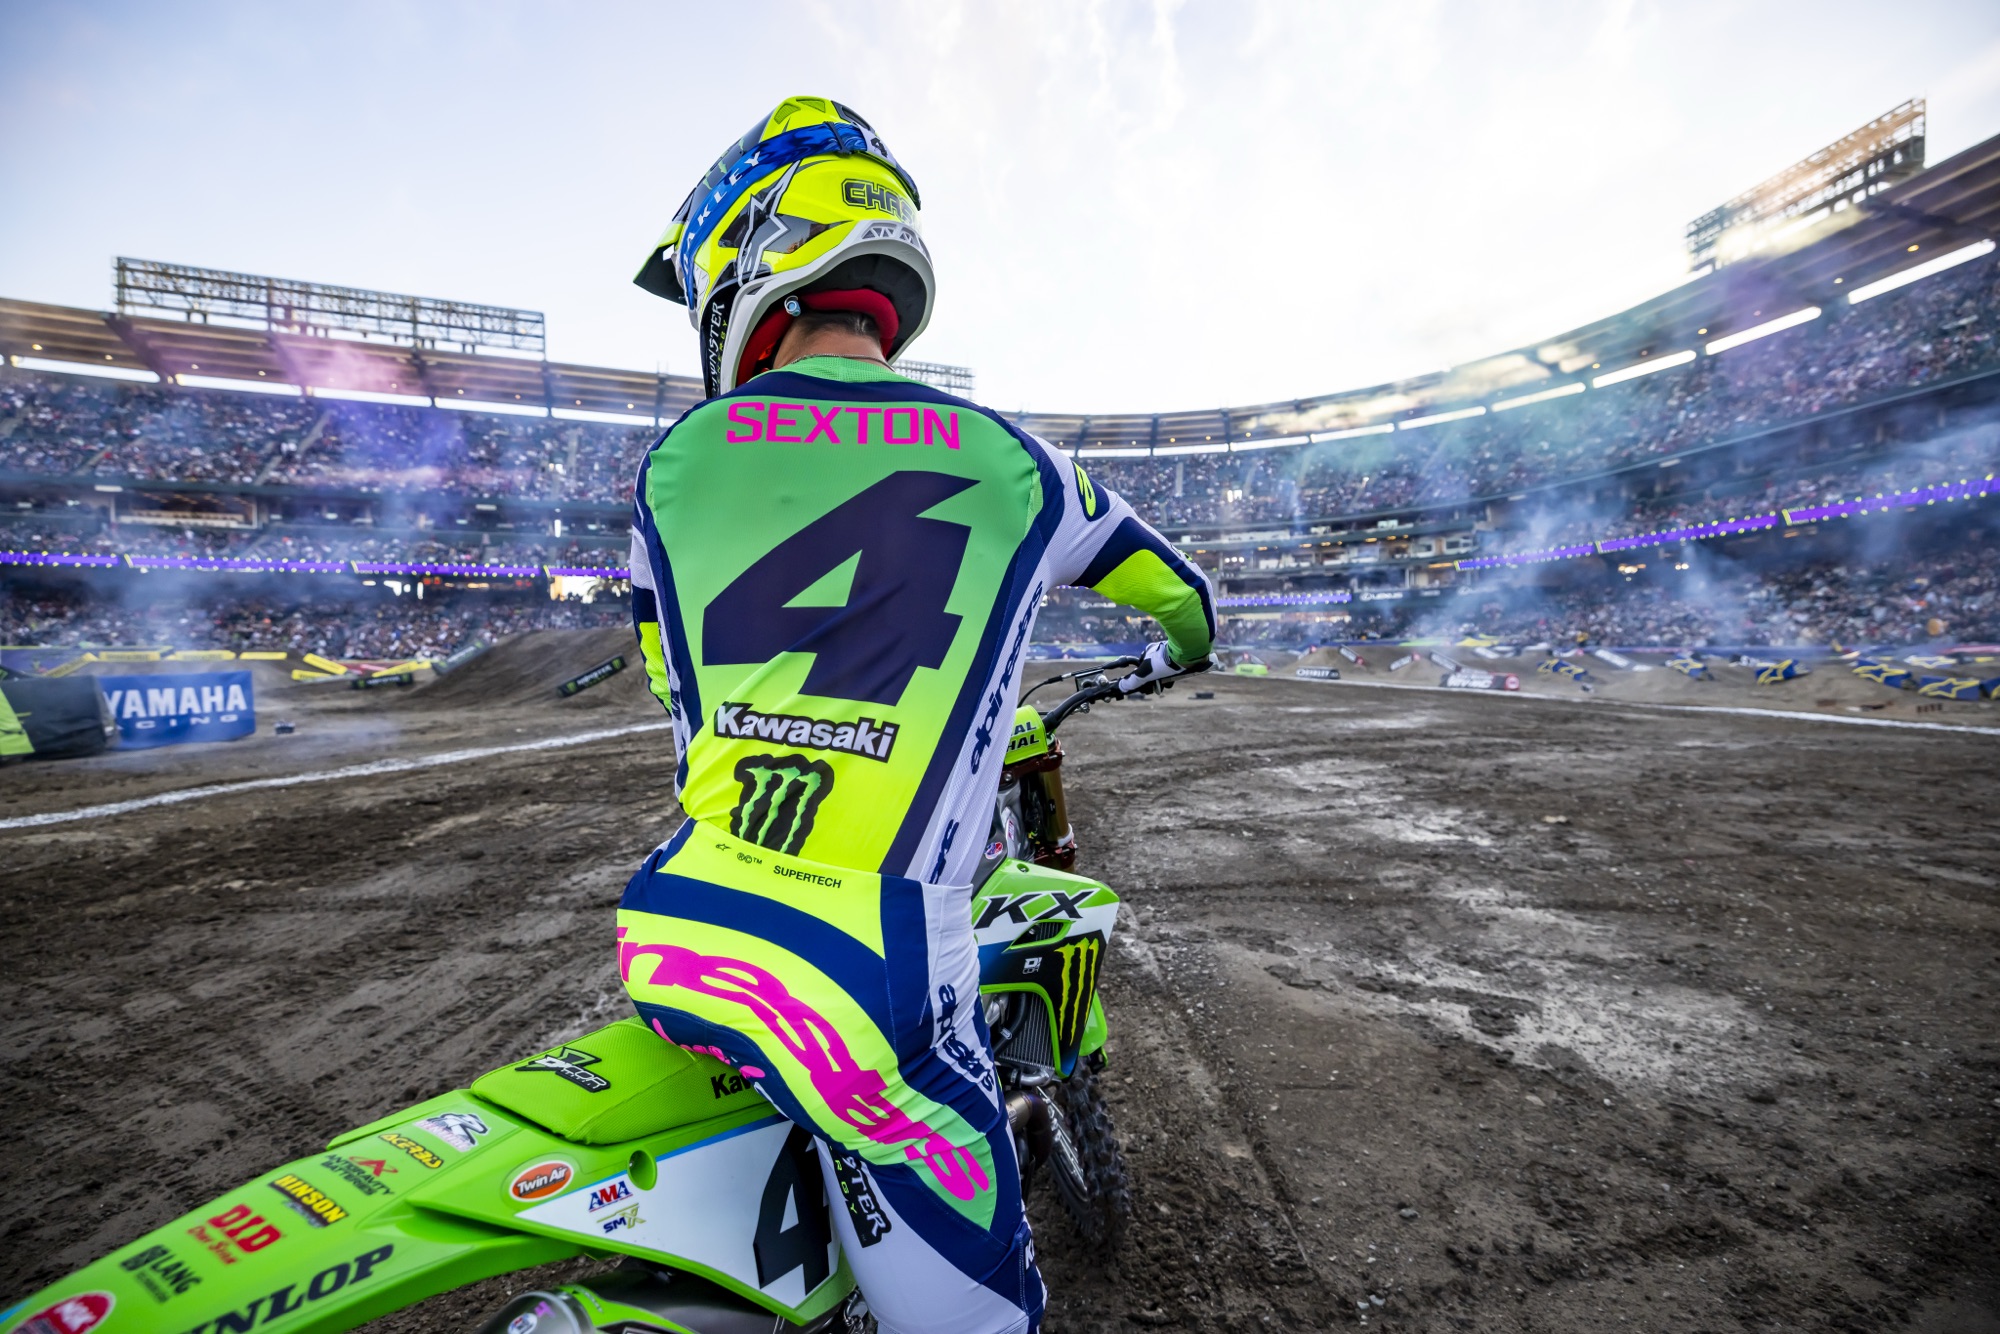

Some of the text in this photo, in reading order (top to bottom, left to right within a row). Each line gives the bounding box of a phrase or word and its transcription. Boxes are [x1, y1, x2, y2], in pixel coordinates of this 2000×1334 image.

[683, 151, 761, 273] OAKLEY
[842, 179, 914, 223] CHAS
[726, 402, 960, 449] SEXTON
[702, 470, 981, 706] 4
[103, 684, 248, 719] YAMAHA
[117, 713, 238, 730] CING
[716, 702, 896, 760] Kawasaki
[773, 865, 842, 888] SUPERTECH
[974, 889, 1100, 929] KX
[273, 1174, 346, 1223] HINSON
[517, 1166, 568, 1195] Twin Air
[589, 1181, 631, 1211] AMA
[842, 1156, 886, 1237] STER
[754, 1122, 831, 1295] 4
[190, 1243, 394, 1334] NLOP
